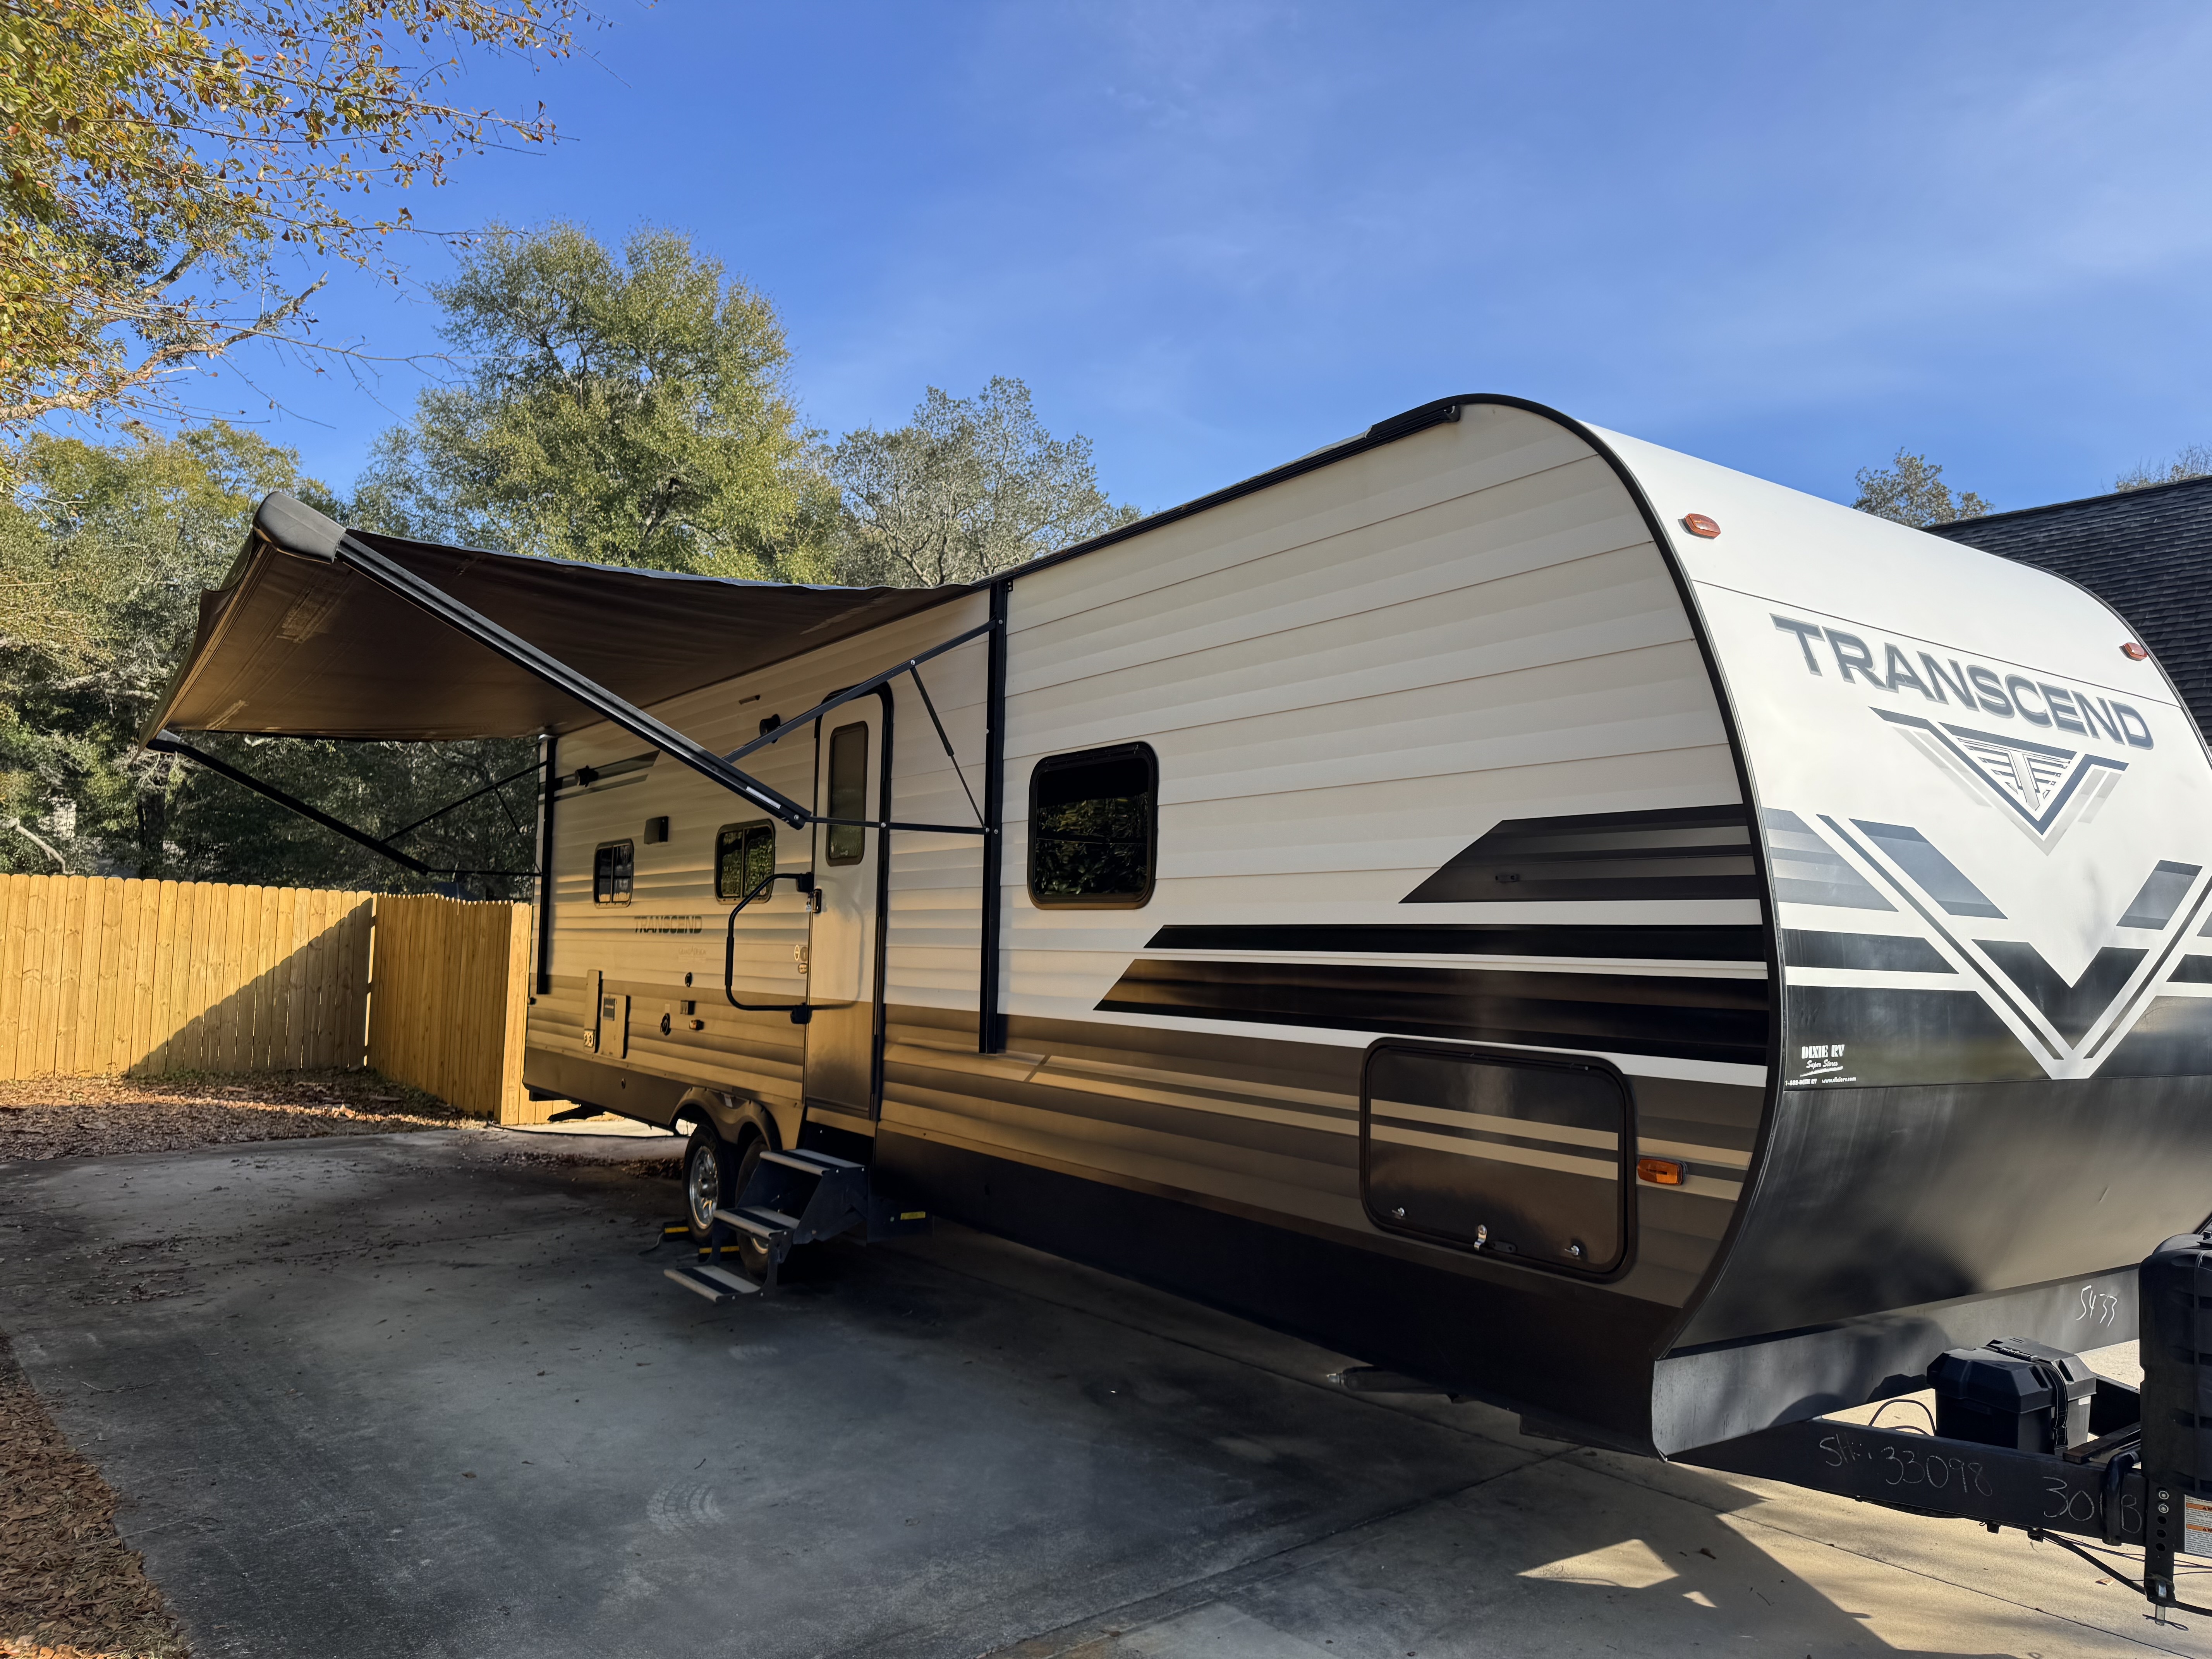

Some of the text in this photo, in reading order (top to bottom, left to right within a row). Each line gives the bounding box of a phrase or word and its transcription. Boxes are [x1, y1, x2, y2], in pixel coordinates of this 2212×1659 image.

[1769, 613, 2154, 750] TRANSCEND
[634, 915, 702, 934] TRANSCEND
[1801, 1044, 1845, 1059] DIXIE RV
[1806, 1059, 1838, 1069] Super Stores
[1881, 1446, 1992, 1497] 33098
